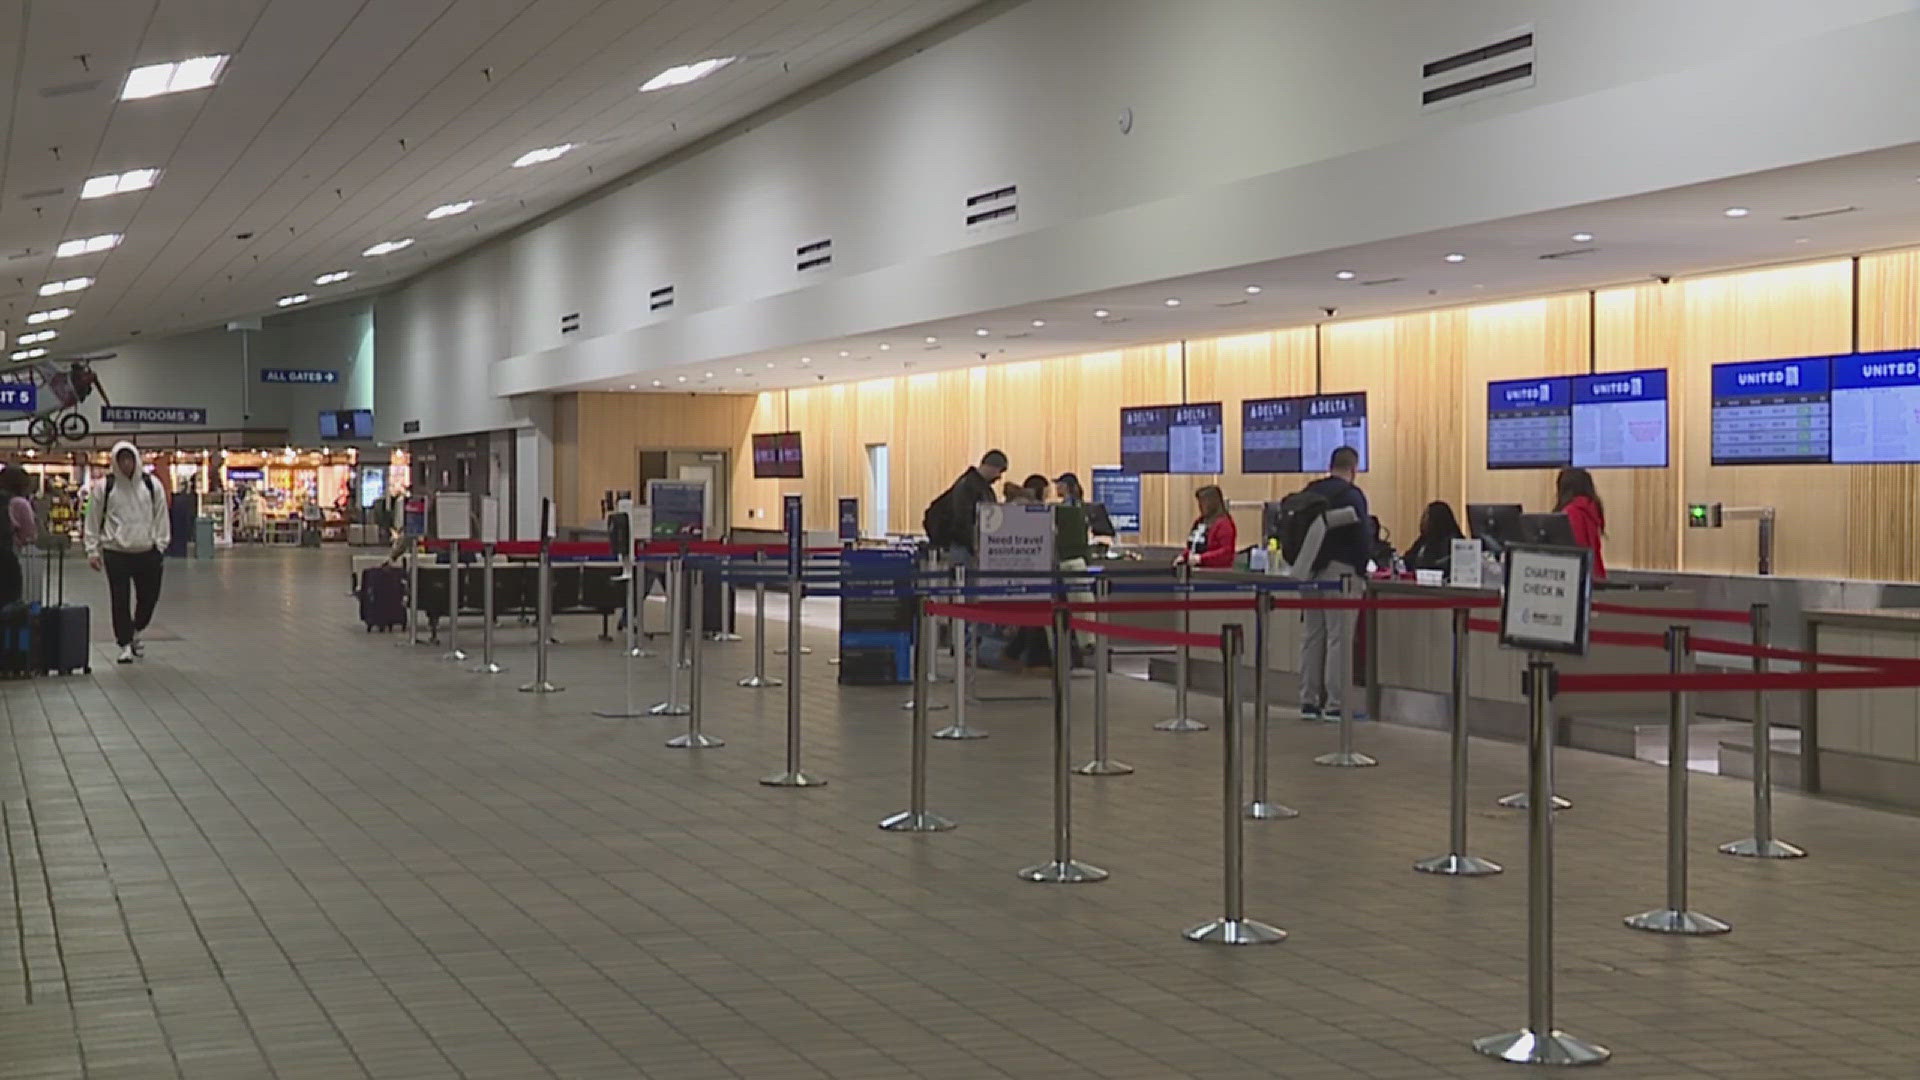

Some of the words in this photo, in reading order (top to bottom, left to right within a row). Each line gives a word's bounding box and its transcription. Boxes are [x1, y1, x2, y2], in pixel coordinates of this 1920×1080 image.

[266, 370, 286, 381] ALL
[289, 370, 322, 382] GATES
[1862, 362, 1916, 377] UNITED
[1738, 371, 1784, 385] UNITED
[1506, 387, 1539, 400] UNITED
[1592, 382, 1630, 395] UNITED
[19, 390, 30, 403] 5
[1258, 403, 1284, 417] DELTA
[1318, 399, 1347, 414] DELTA
[106, 409, 186, 422] RESTROOMS
[988, 535, 1013, 545] Need
[1014, 535, 1044, 545] travel
[988, 546, 1042, 556] assistance?
[1524, 566, 1566, 582] CHARTER
[1523, 583, 1553, 596] CHECK
[1555, 587, 1565, 598] IN
